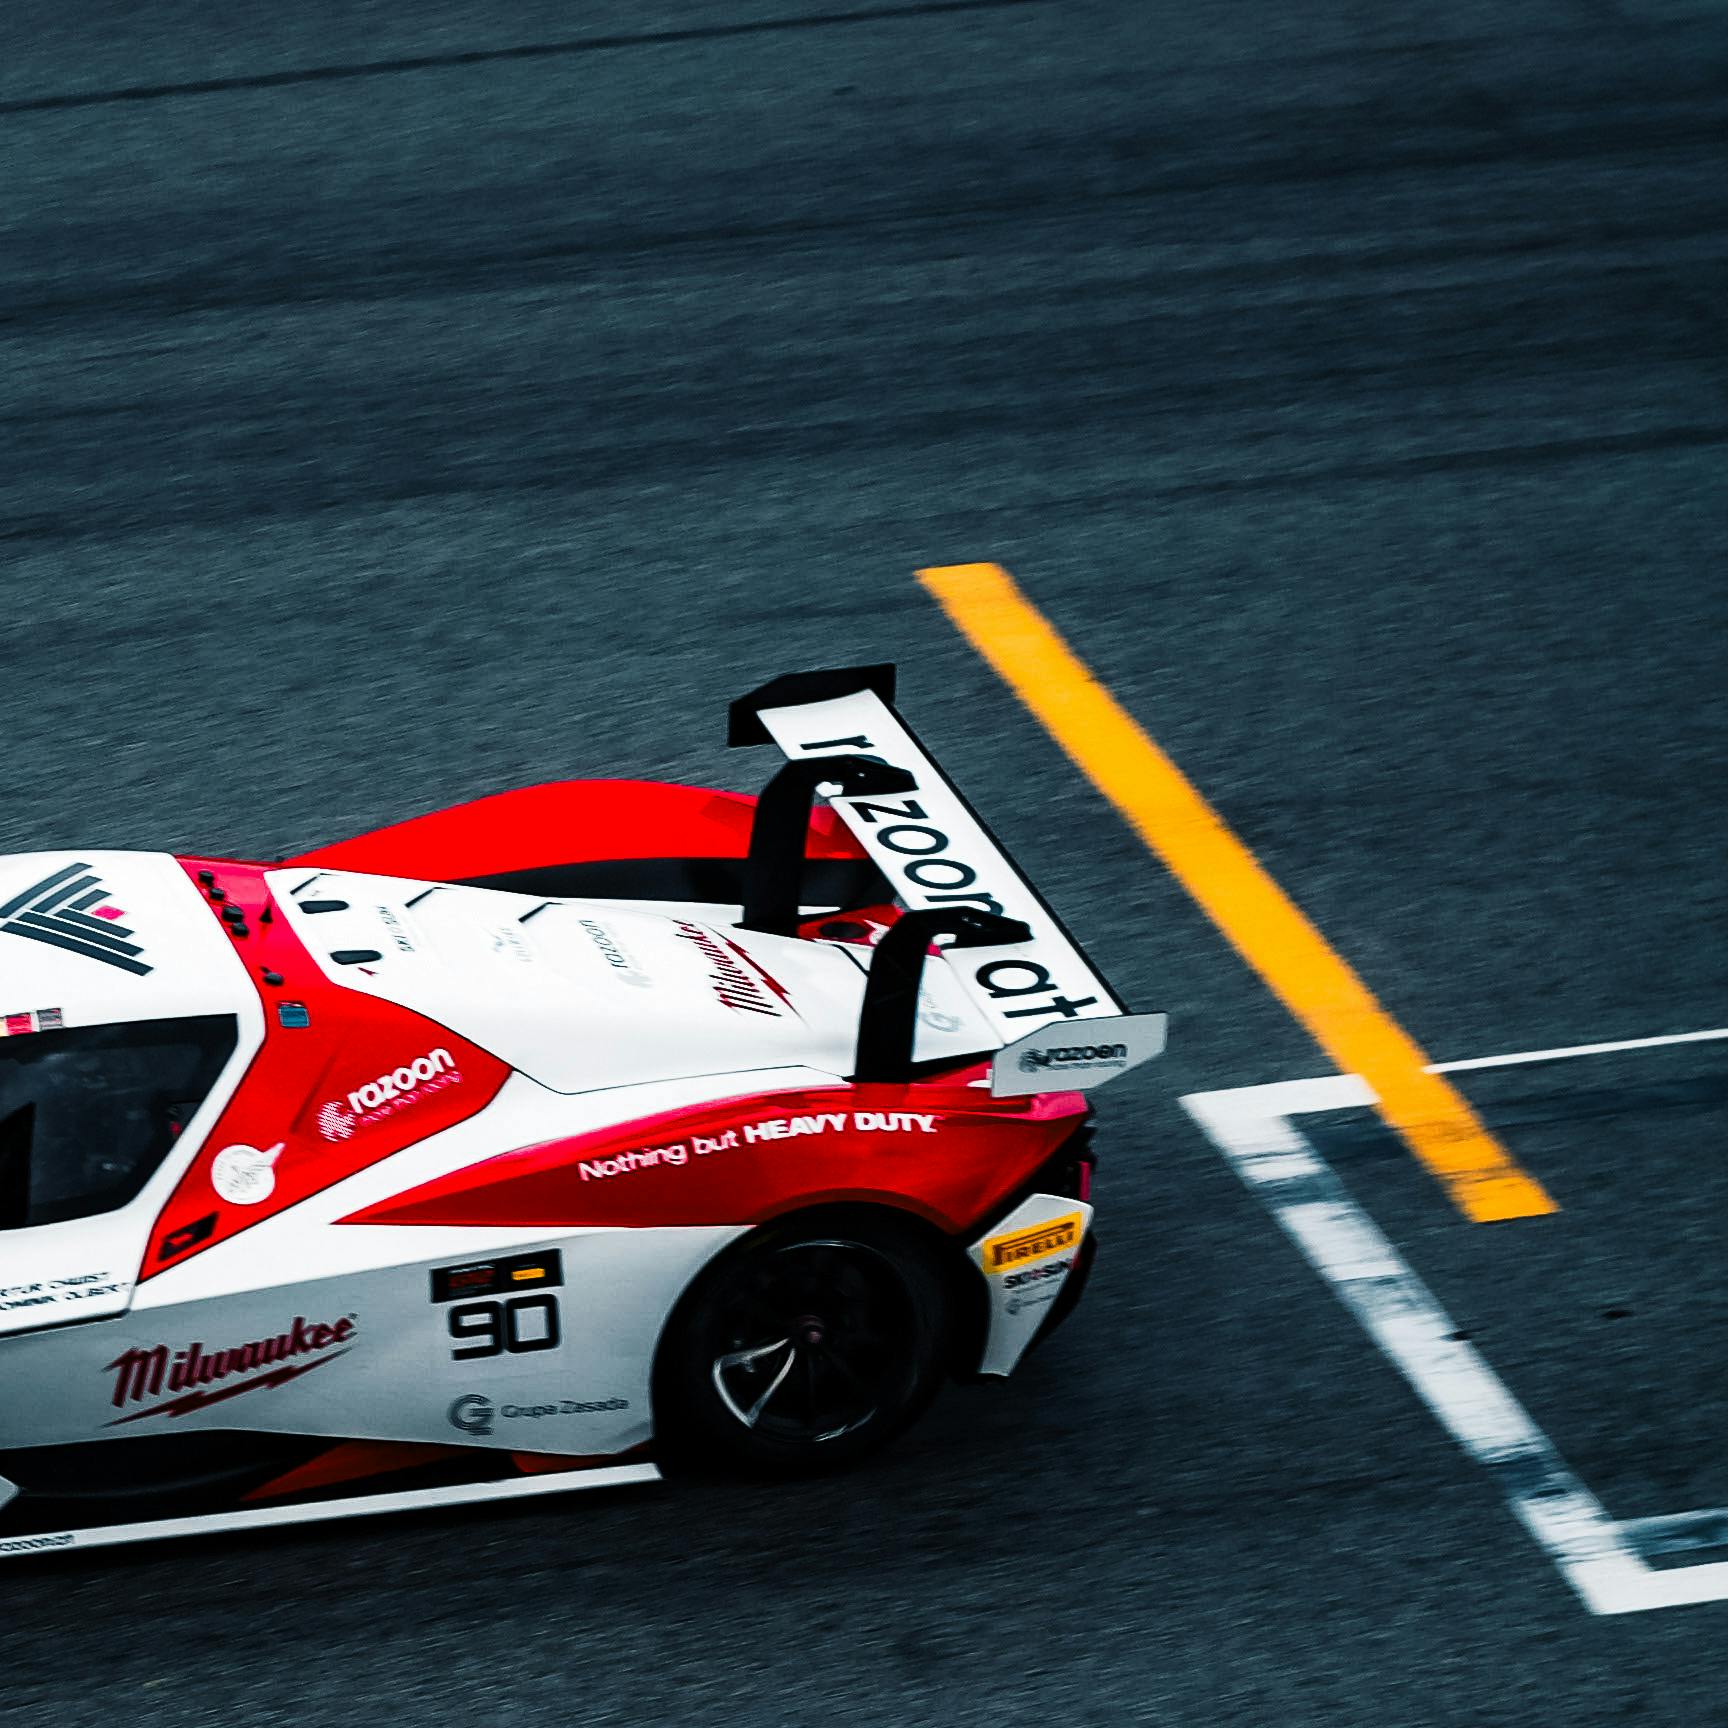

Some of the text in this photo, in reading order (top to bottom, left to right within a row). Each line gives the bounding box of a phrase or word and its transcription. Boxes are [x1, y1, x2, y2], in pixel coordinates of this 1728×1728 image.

[347, 1048, 455, 1113] razoon
[578, 1144, 687, 1181] Nothing
[692, 1129, 739, 1155] but
[744, 1113, 846, 1144] HEAVY
[992, 1222, 1074, 1265] PIRELLI
[449, 1294, 560, 1360] 90
[101, 1315, 357, 1408] Milwaukee
